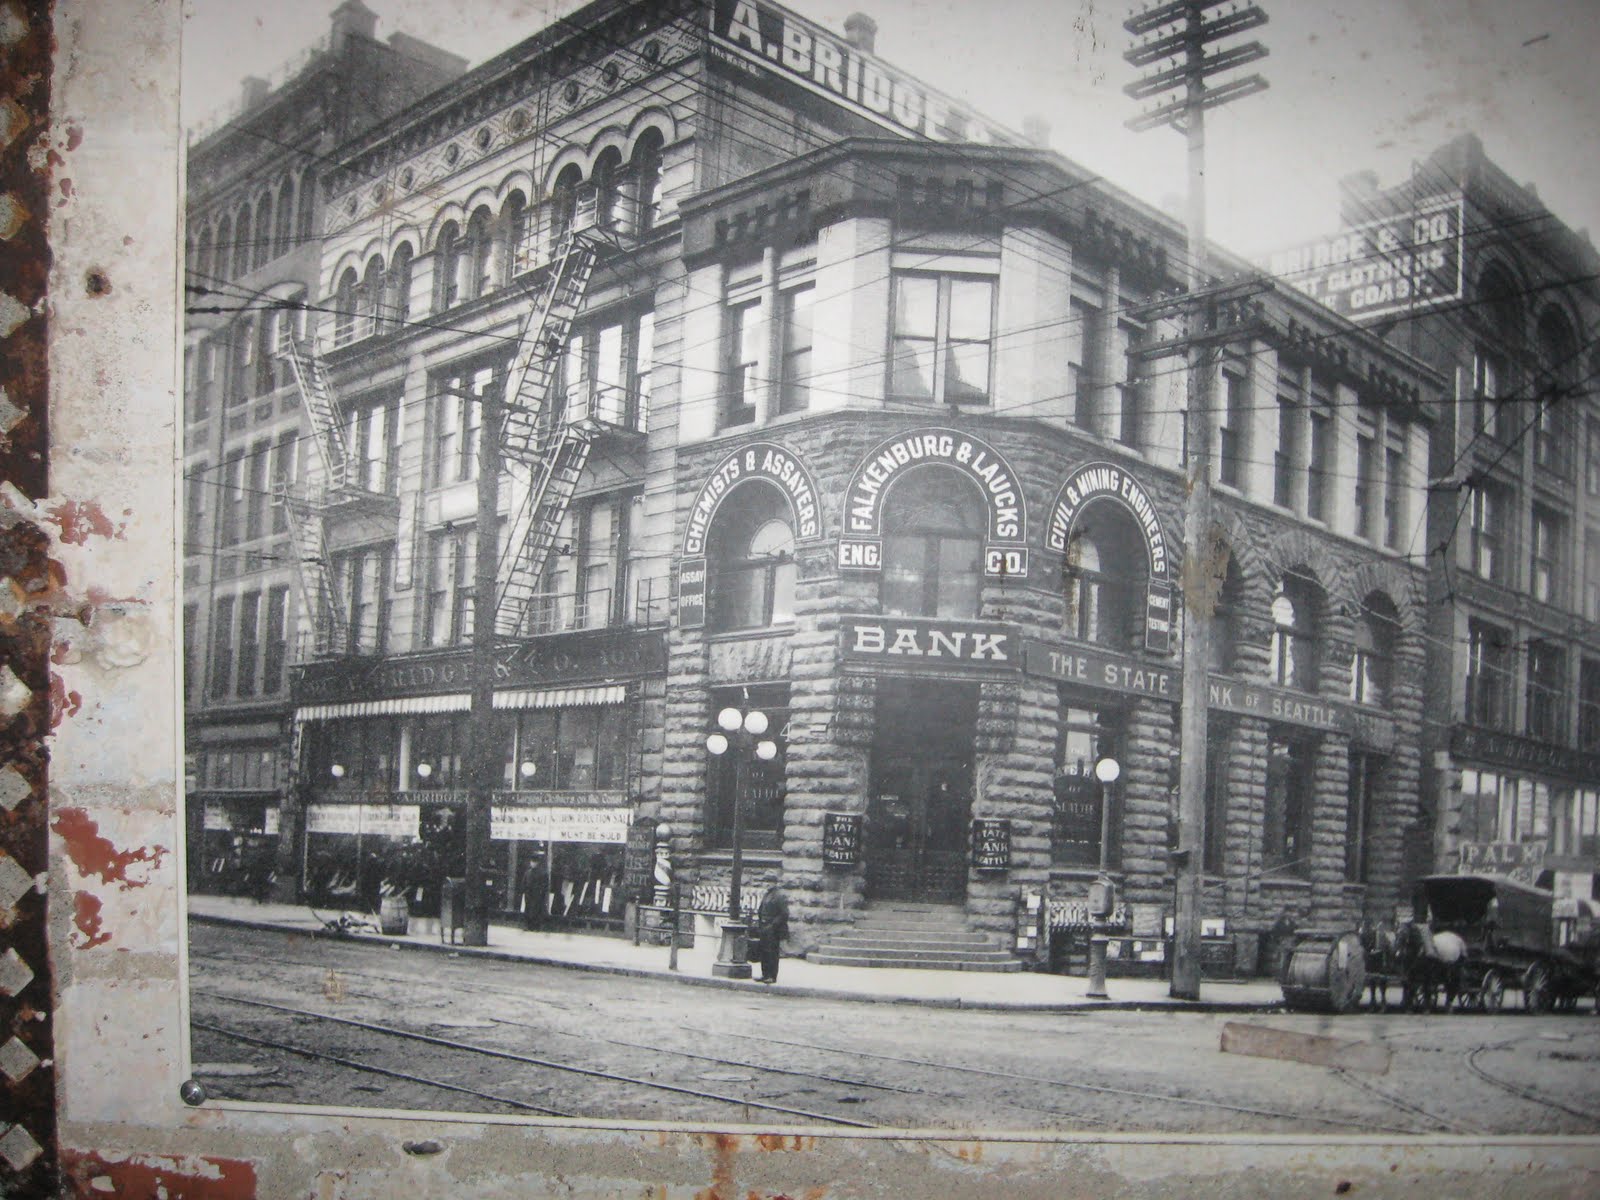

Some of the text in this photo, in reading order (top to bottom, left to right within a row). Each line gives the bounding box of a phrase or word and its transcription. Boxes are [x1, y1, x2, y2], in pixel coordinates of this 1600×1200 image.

[686, 457, 741, 553] CHEMISTS
[761, 450, 816, 537] ASSAYERS
[851, 435, 1018, 538] FALKENBURG & LAUCKS
[1051, 502, 1073, 550] CIVIL
[1076, 468, 1119, 497] MINING
[1121, 476, 1165, 573] ENGINEERS
[852, 625, 1008, 660] BANK
[1050, 651, 1088, 679] THE
[1104, 663, 1170, 695] STATE
[1209, 685, 1233, 707] NK
[1245, 694, 1259, 707] OF
